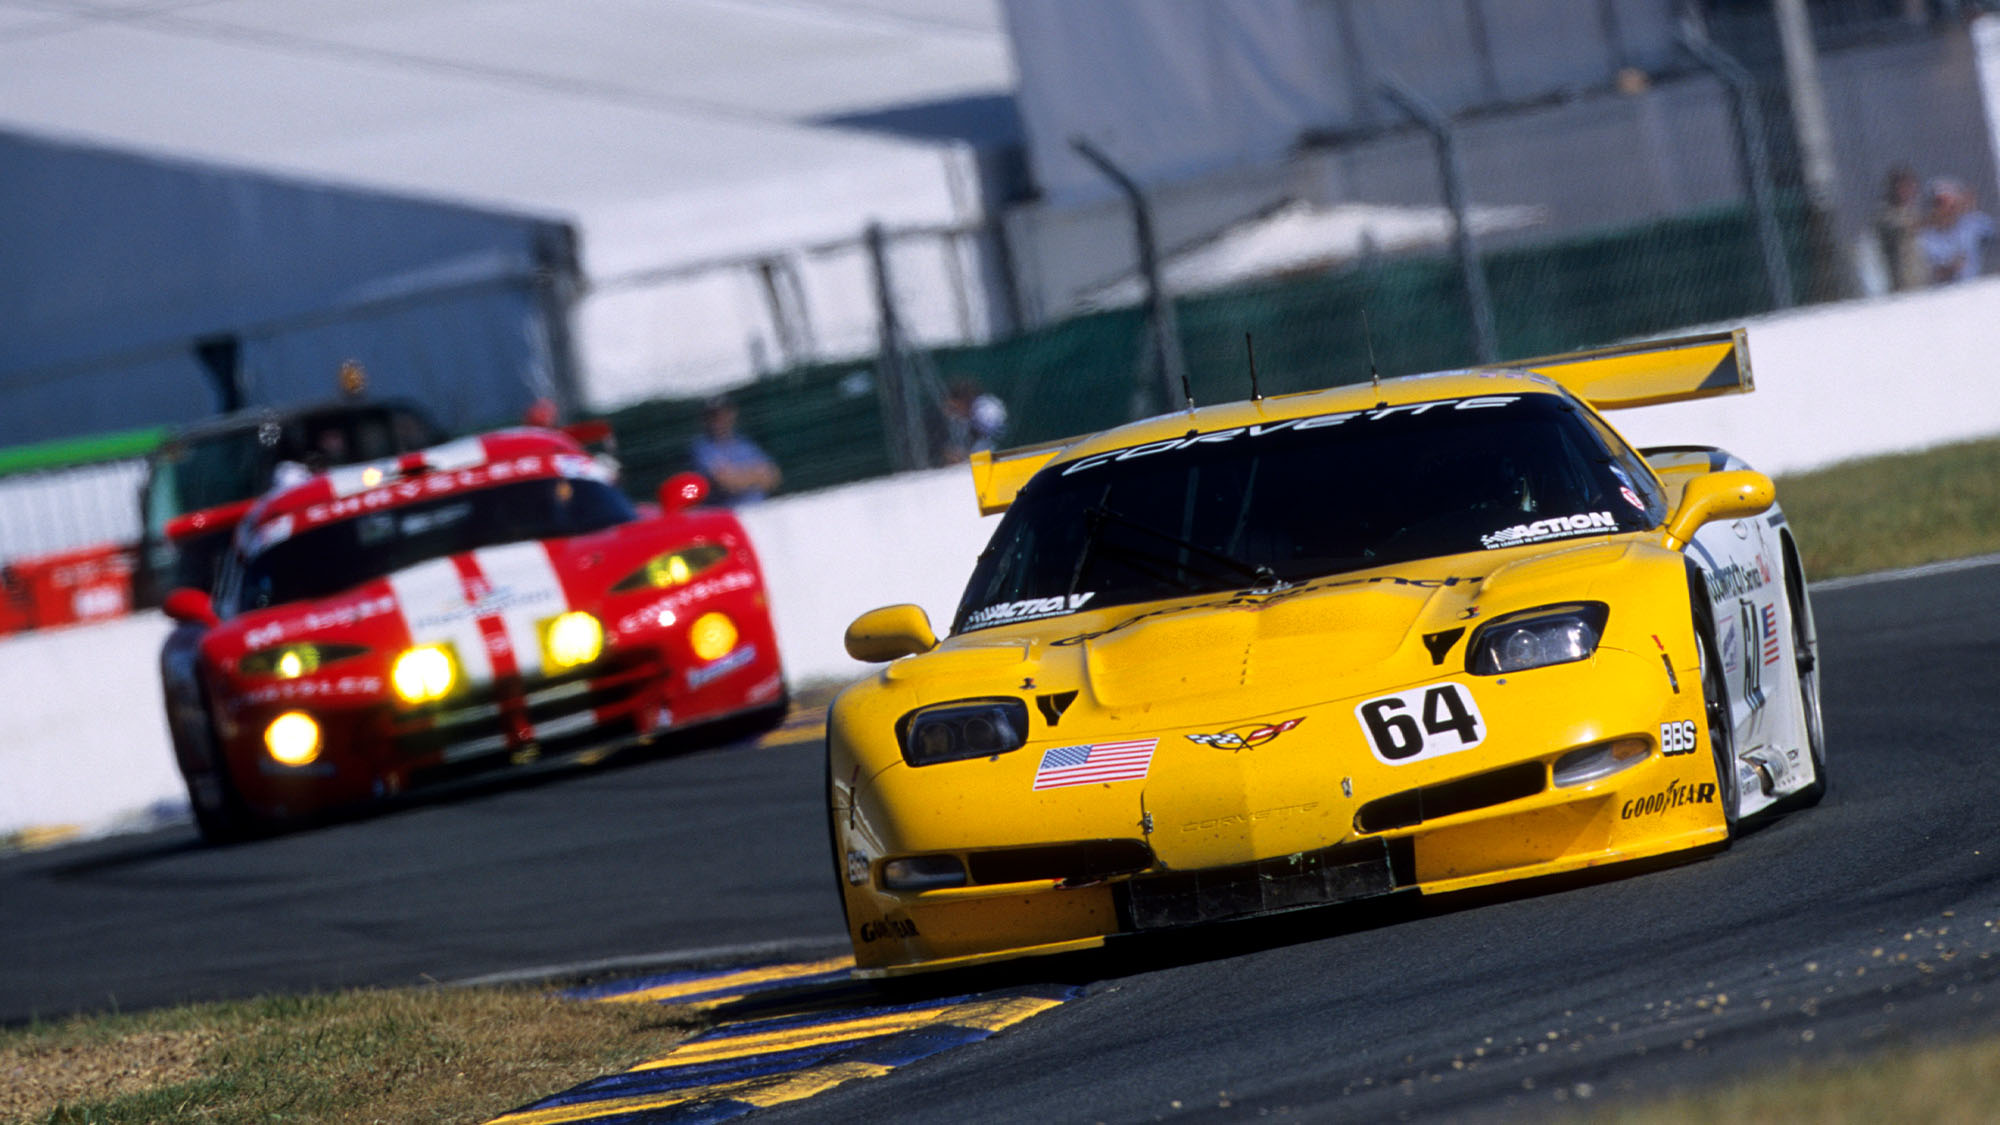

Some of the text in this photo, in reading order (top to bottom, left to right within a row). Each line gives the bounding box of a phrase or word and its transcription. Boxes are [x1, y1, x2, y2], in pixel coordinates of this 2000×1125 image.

[1062, 396, 1522, 477] CORVETTE
[1510, 511, 1616, 540] ACTION
[984, 592, 1096, 620] ACTION
[1360, 684, 1479, 760] 64
[1660, 719, 1697, 757] BBS
[1179, 801, 1320, 833] CORVETTE
[1621, 778, 1716, 820] GOODYEAR
